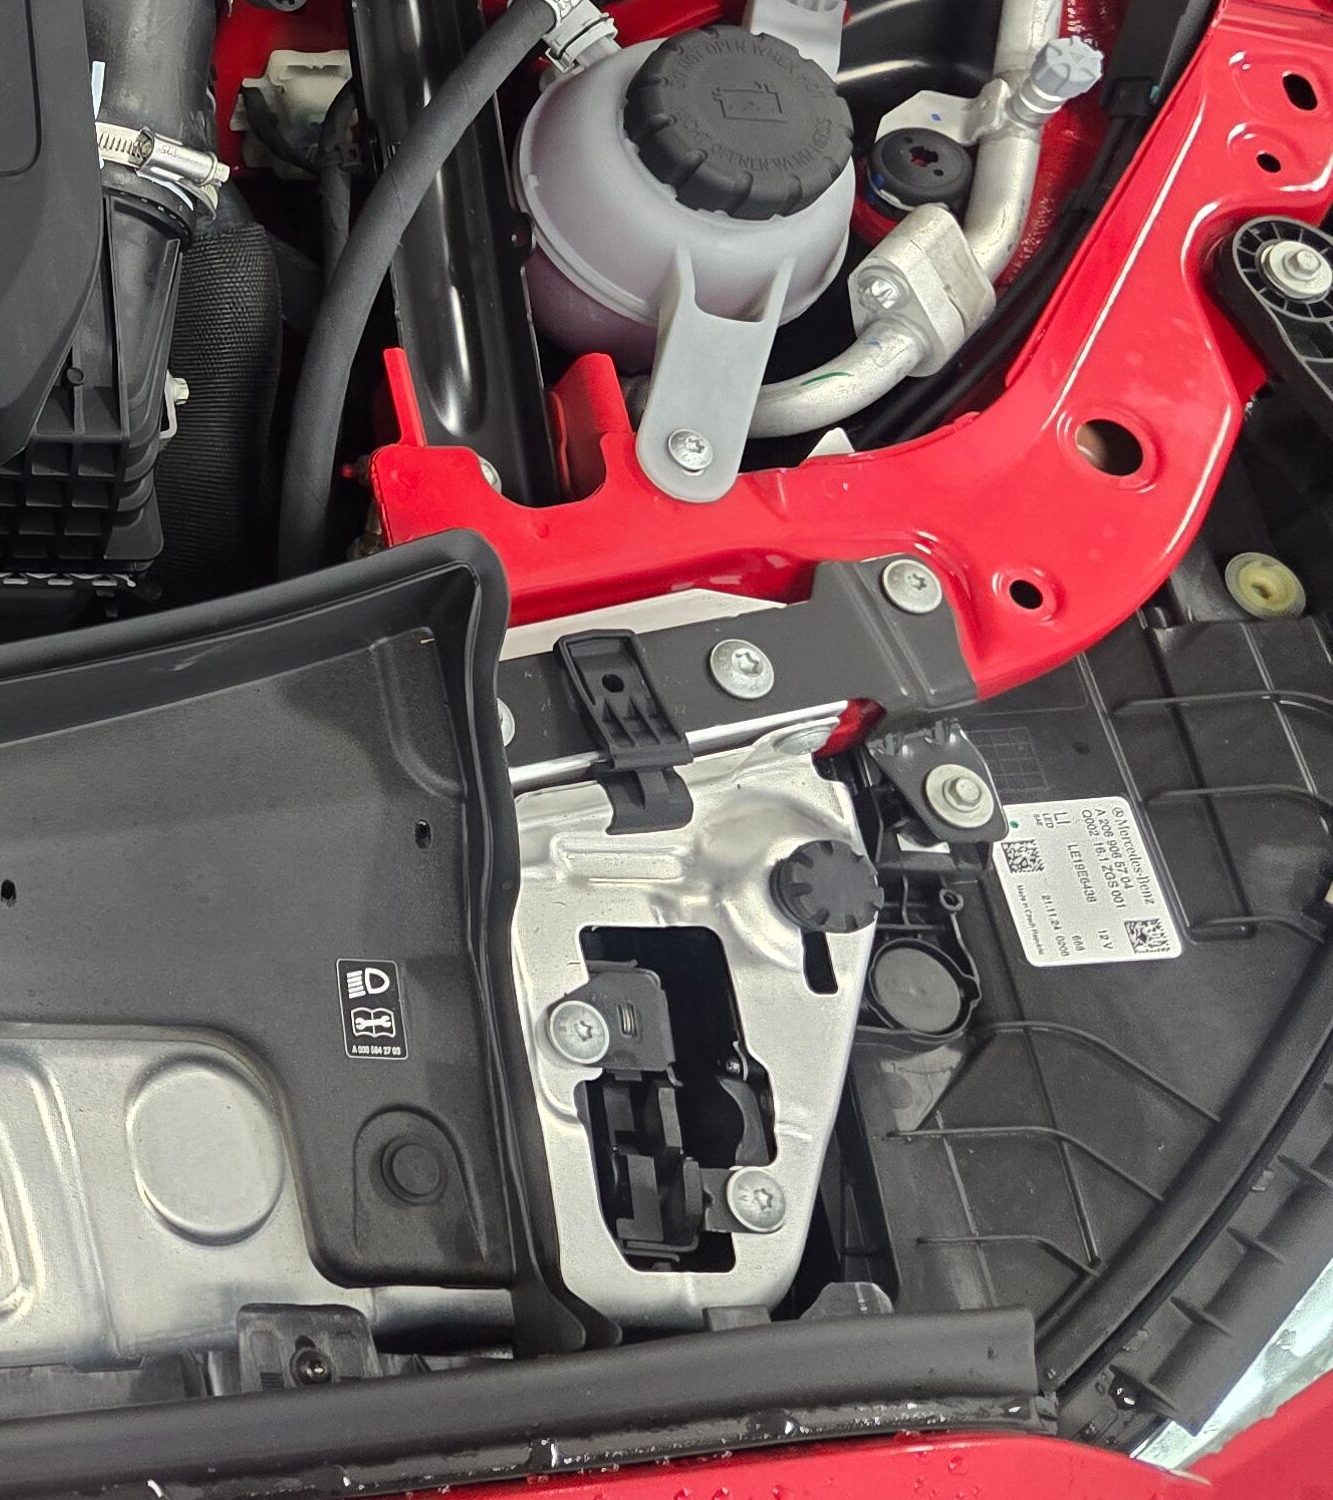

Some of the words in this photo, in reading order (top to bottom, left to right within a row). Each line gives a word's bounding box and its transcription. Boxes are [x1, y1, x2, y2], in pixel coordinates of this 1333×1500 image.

[1094, 809, 1107, 817] A
[1099, 819, 1114, 838] 206
[1107, 840, 1122, 859] 906
[1116, 818, 1155, 905] Mercedes-Benz
